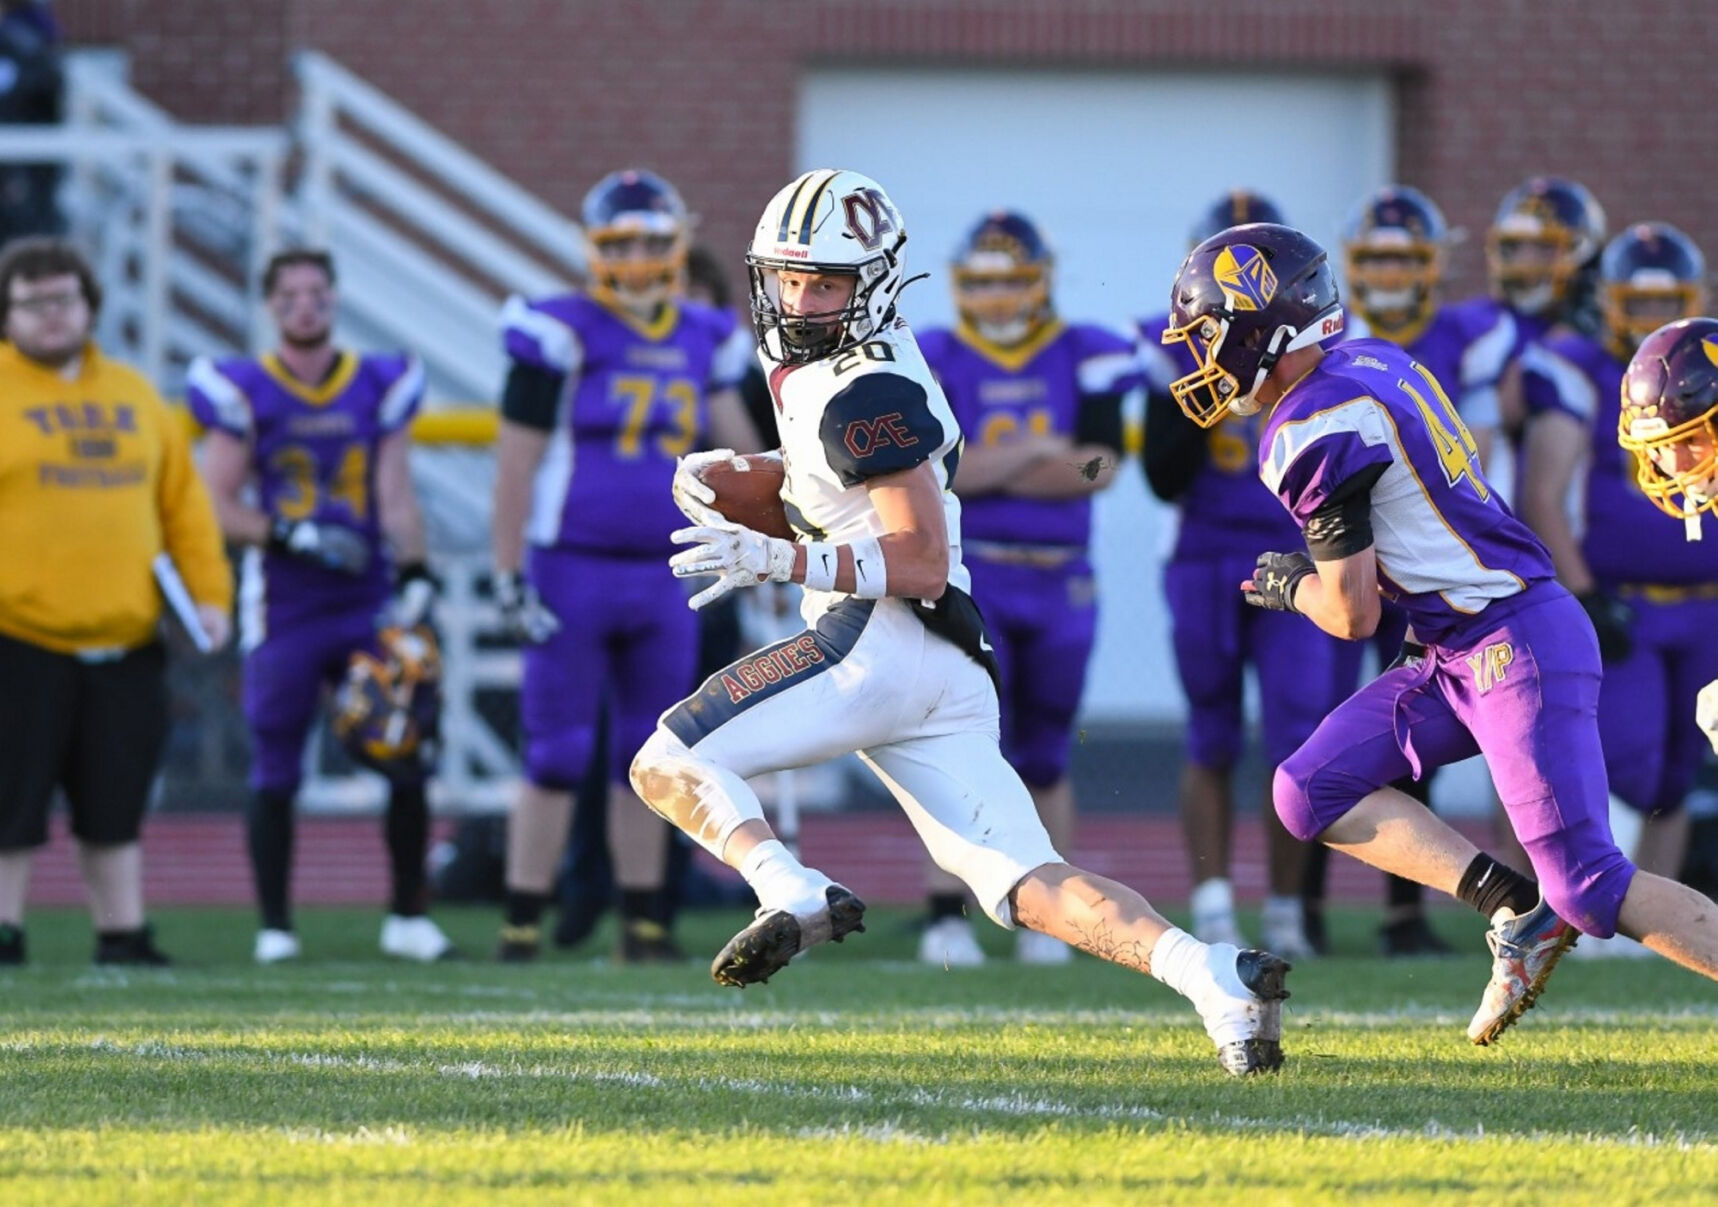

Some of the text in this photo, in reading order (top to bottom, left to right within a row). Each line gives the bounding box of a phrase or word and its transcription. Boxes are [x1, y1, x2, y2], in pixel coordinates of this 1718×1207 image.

[612, 376, 697, 459] 73
[270, 445, 367, 520] 34
[720, 636, 825, 705] AGGIES
